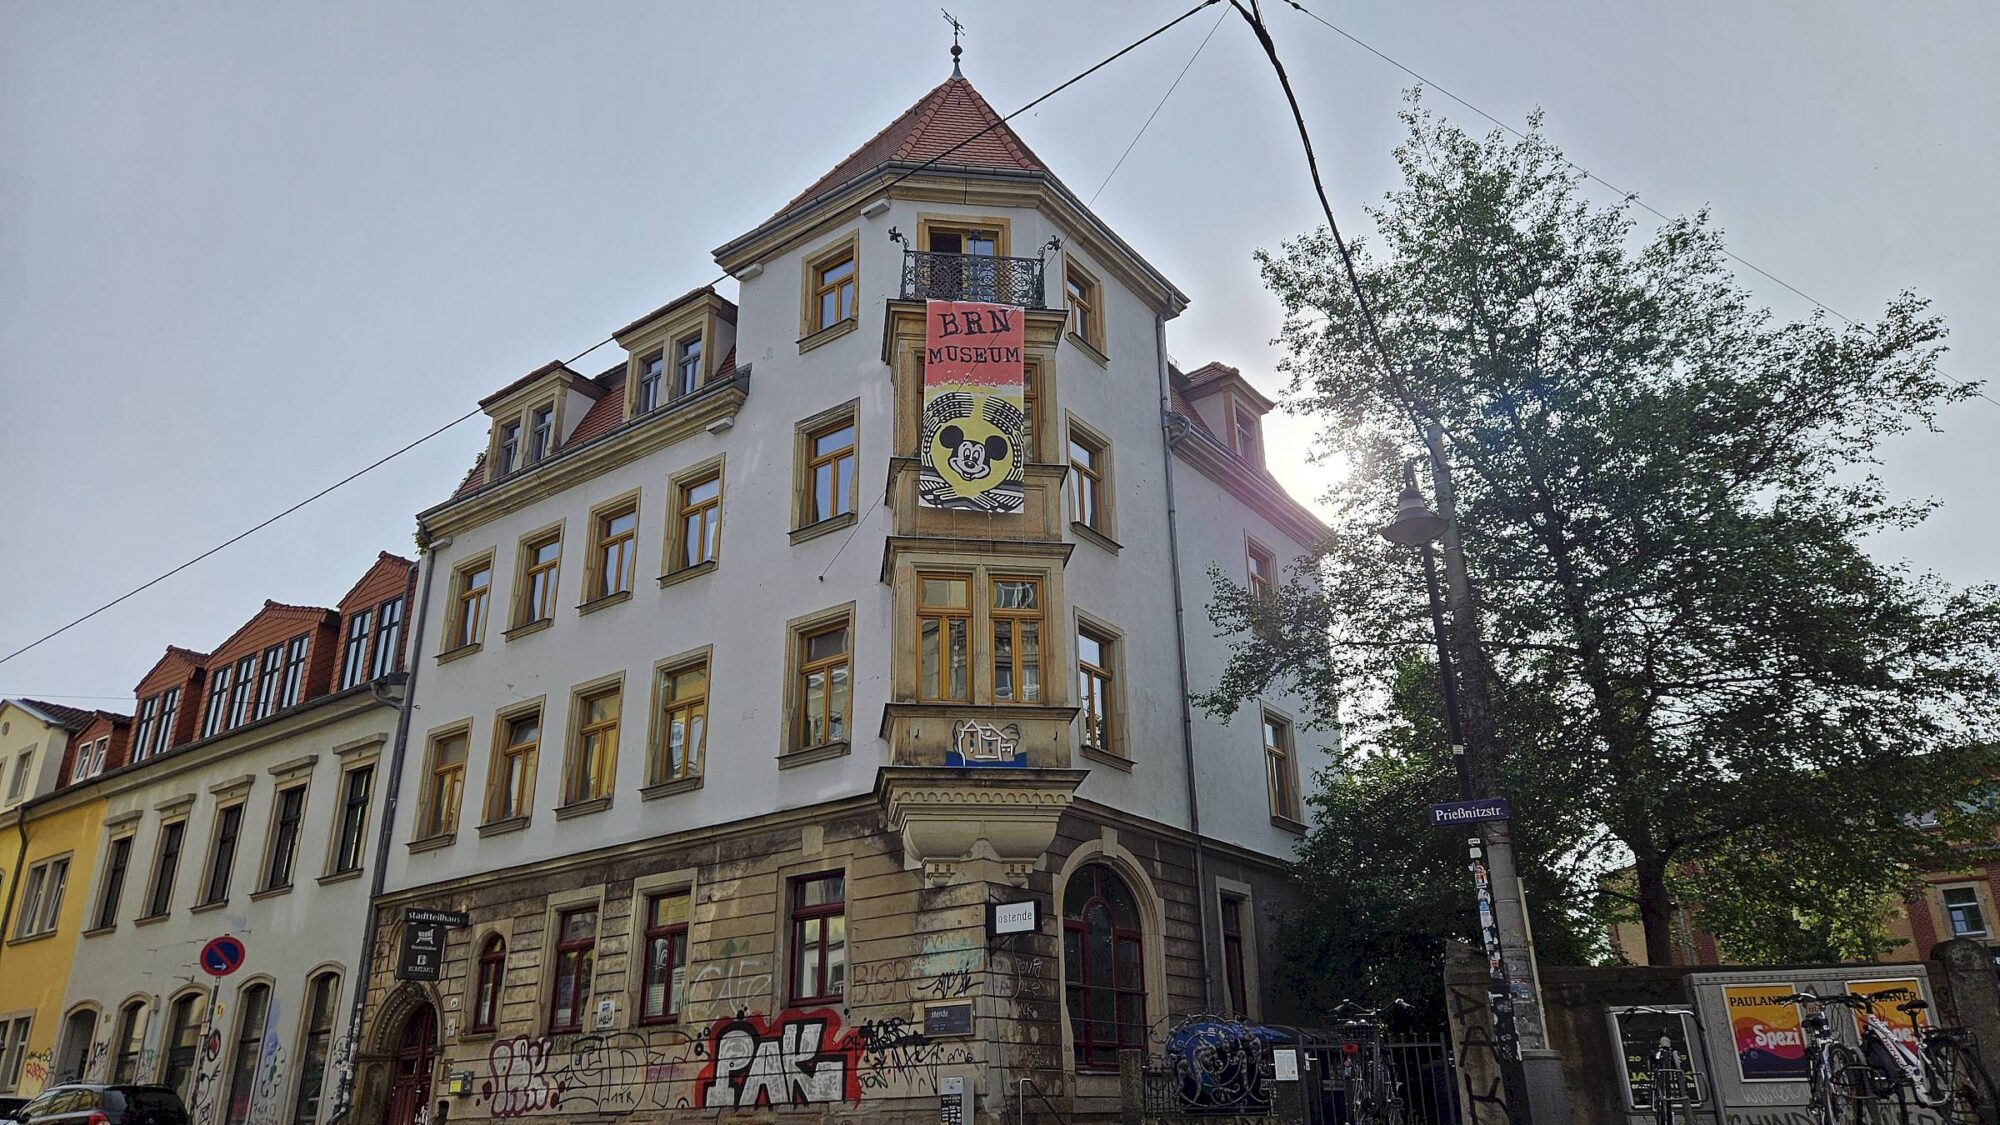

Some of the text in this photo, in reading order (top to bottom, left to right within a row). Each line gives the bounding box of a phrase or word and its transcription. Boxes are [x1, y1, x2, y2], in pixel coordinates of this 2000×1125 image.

[936, 309, 1012, 338] BRN
[928, 345, 1022, 364] MUSEUM
[1435, 806, 1504, 821] Prießnitzstr.
[408, 912, 460, 923] stadtteilhaus
[997, 910, 1033, 924] ostende
[1729, 996, 1789, 1007] PAULAN
[1753, 1024, 1801, 1049] Spezi
[703, 1014, 848, 1109] PAK
